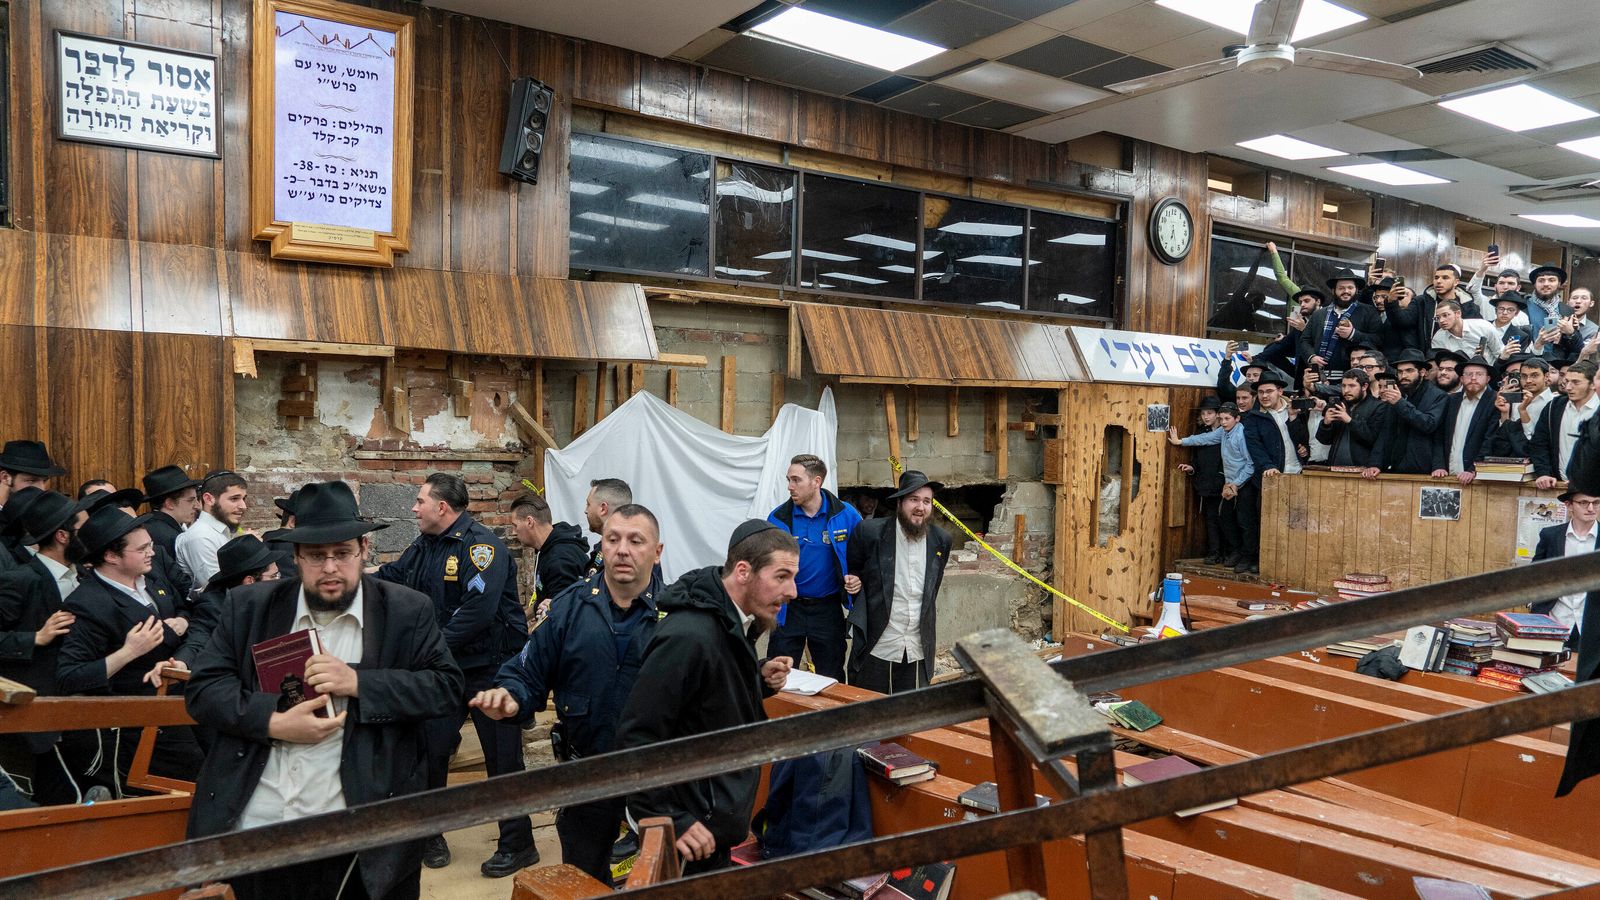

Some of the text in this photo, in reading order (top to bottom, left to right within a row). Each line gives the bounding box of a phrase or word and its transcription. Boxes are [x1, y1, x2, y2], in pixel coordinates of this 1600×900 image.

[295, 59, 378, 80] חומש, שני עם
[288, 113, 383, 134] תהילים: פרקים
[350, 168, 378, 179] תניא
[310, 177, 339, 189] בדבר
[339, 196, 382, 208] צדיקים
[1100, 338, 1169, 380] ועד!
